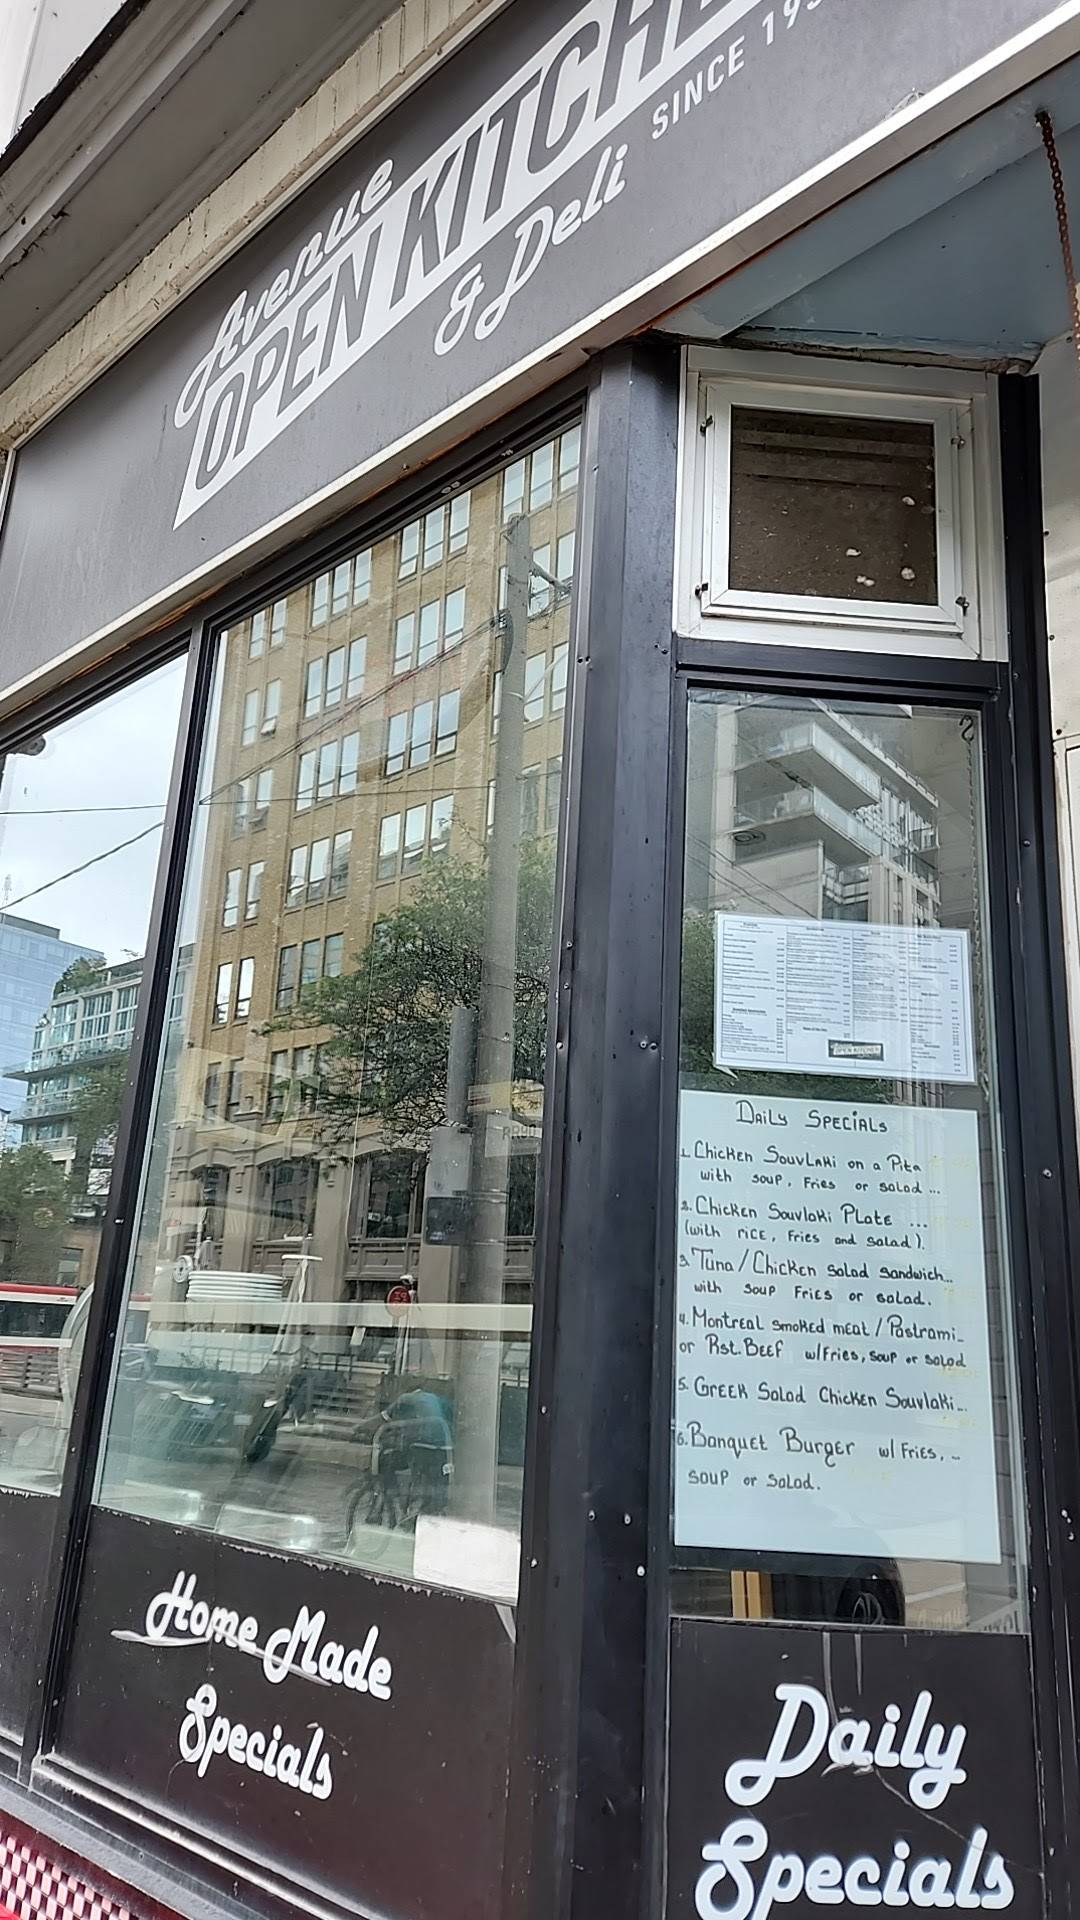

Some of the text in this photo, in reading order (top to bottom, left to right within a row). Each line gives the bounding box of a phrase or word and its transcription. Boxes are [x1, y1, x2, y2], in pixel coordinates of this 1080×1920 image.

[651, 35, 745, 140] SINCE
[433, 144, 629, 357] & Deli
[174, 159, 394, 429] Avenue
[195, 228, 384, 490] OPEN
[700, 1167, 732, 1183] with
[803, 1176, 836, 1190] Fries
[855, 1183, 868, 1191] or
[848, 1159, 864, 1170] on
[873, 1162, 881, 1171] a
[887, 1154, 922, 1173] Pita
[696, 1195, 757, 1219] Chicken
[768, 1202, 832, 1223] Souvlaki
[840, 1203, 893, 1226] Plate
[684, 1219, 721, 1238] (with
[787, 1230, 820, 1243] Fries
[834, 1233, 857, 1245] and
[694, 1280, 722, 1293] with
[794, 1285, 833, 1300] Fries
[849, 1292, 864, 1301] or
[692, 1305, 765, 1330] Montreal
[679, 1342, 696, 1354] or
[905, 1355, 918, 1364] or
[757, 1381, 807, 1403] Salad
[819, 1385, 878, 1407] Chicken
[687, 1421, 768, 1459] Banquet
[779, 1426, 855, 1467] Burger
[743, 1476, 758, 1487] or
[146, 1570, 392, 1700] Home Made
[179, 1683, 333, 1800] Specials
[725, 1683, 967, 1809] Daily
[695, 1818, 1015, 1920] Specials
